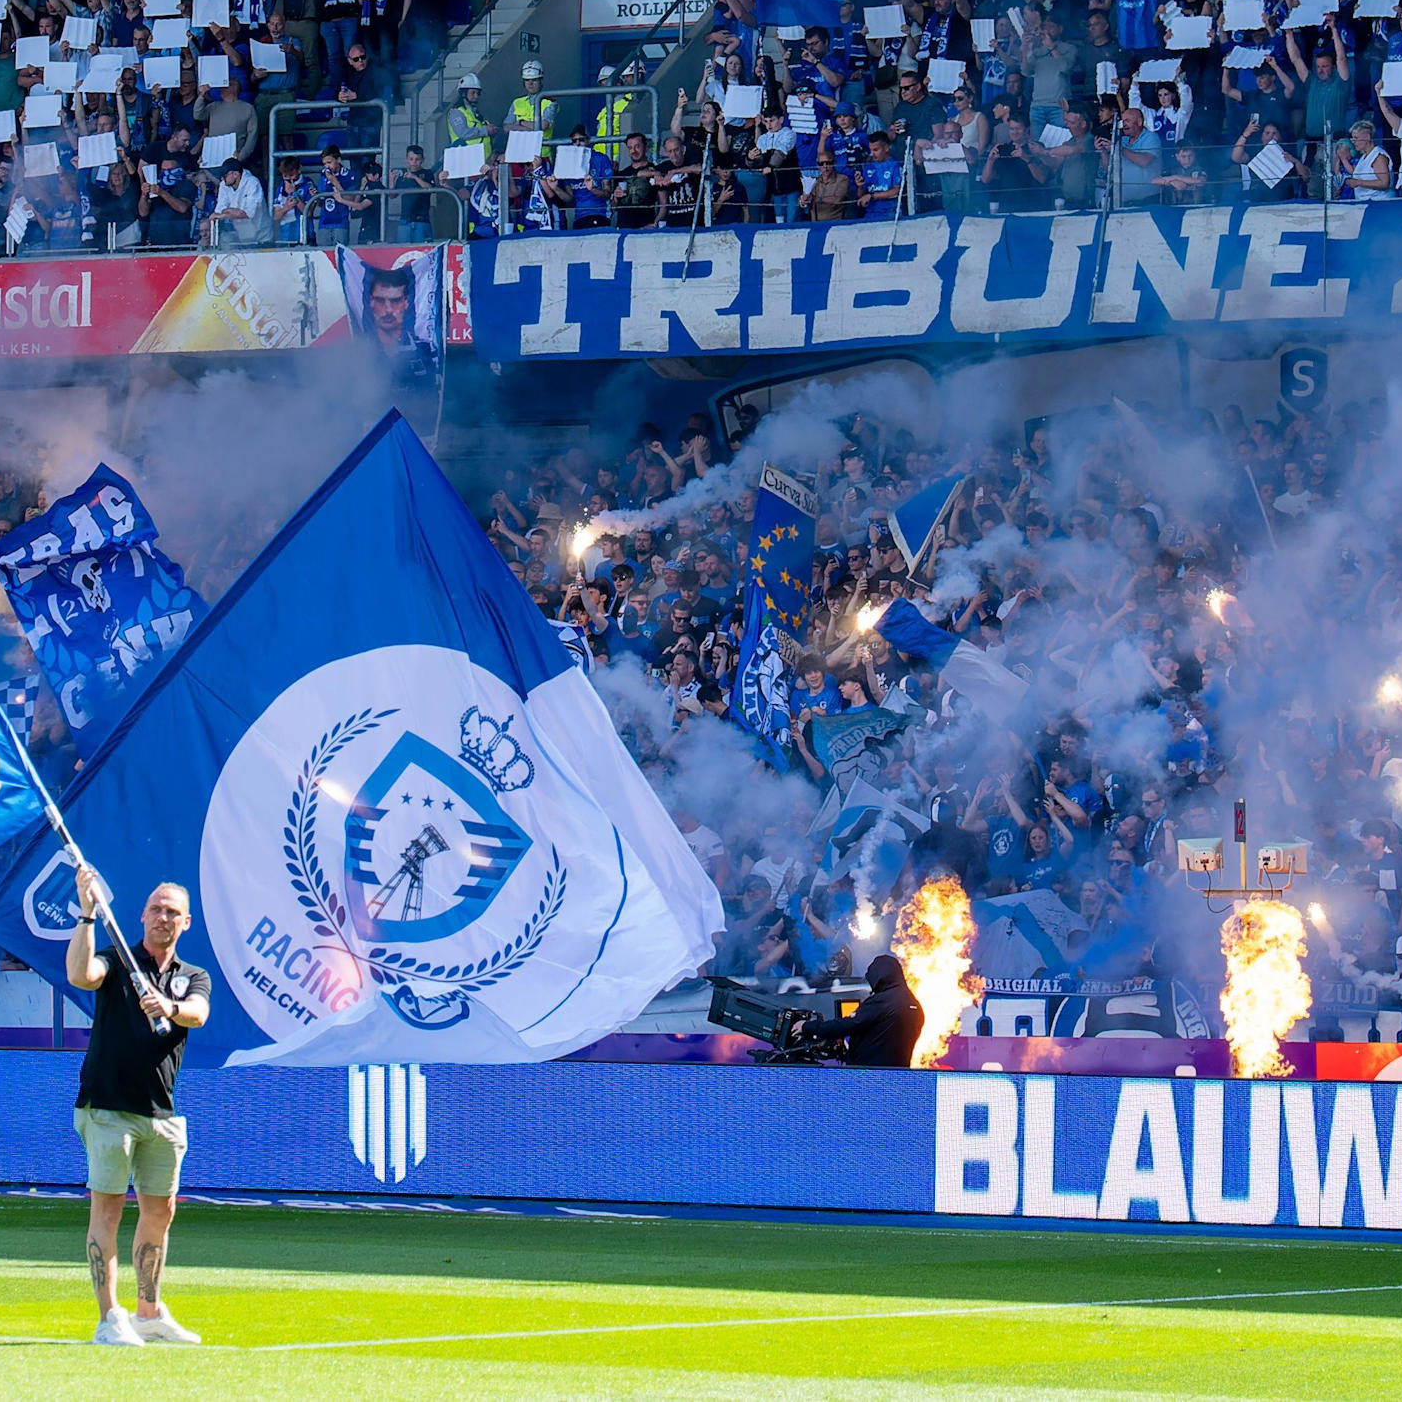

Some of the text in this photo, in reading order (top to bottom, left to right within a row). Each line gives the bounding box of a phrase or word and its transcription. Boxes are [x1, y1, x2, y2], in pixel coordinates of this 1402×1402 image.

[493, 204, 1363, 355] TRIBUNE
[206, 253, 298, 348] Cristal
[1292, 359, 1315, 398] S
[764, 468, 801, 506] Curva
[38, 902, 67, 927] GENK
[247, 916, 359, 1013] RACING
[243, 965, 319, 1026] HELCHT
[984, 978, 1063, 993] ORIGINAL
[1322, 982, 1377, 1005] ZUID
